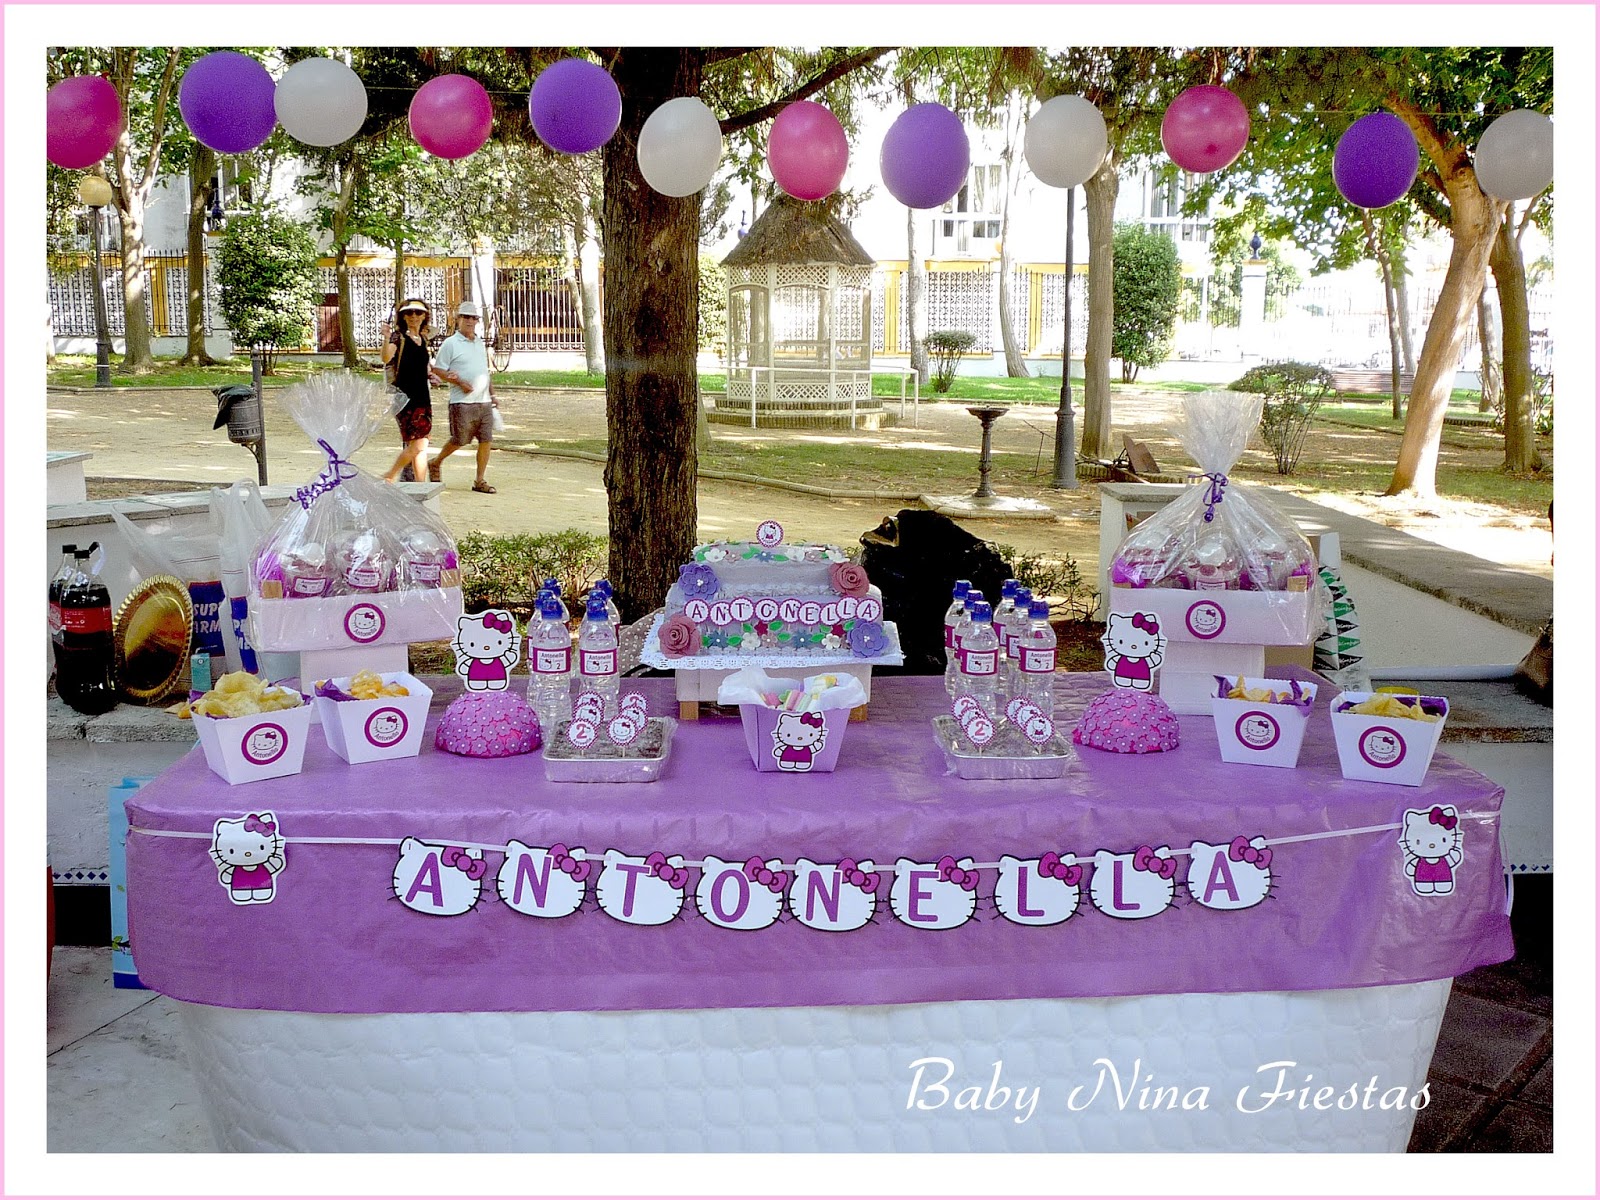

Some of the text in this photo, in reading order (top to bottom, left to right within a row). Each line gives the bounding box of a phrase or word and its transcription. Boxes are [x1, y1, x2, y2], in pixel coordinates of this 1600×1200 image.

[193, 602, 221, 617] SUP
[691, 602, 875, 623] ANTONELLA
[576, 723, 588, 739] 2
[974, 720, 987, 737] 2
[404, 849, 1241, 924] ANTONELLA
